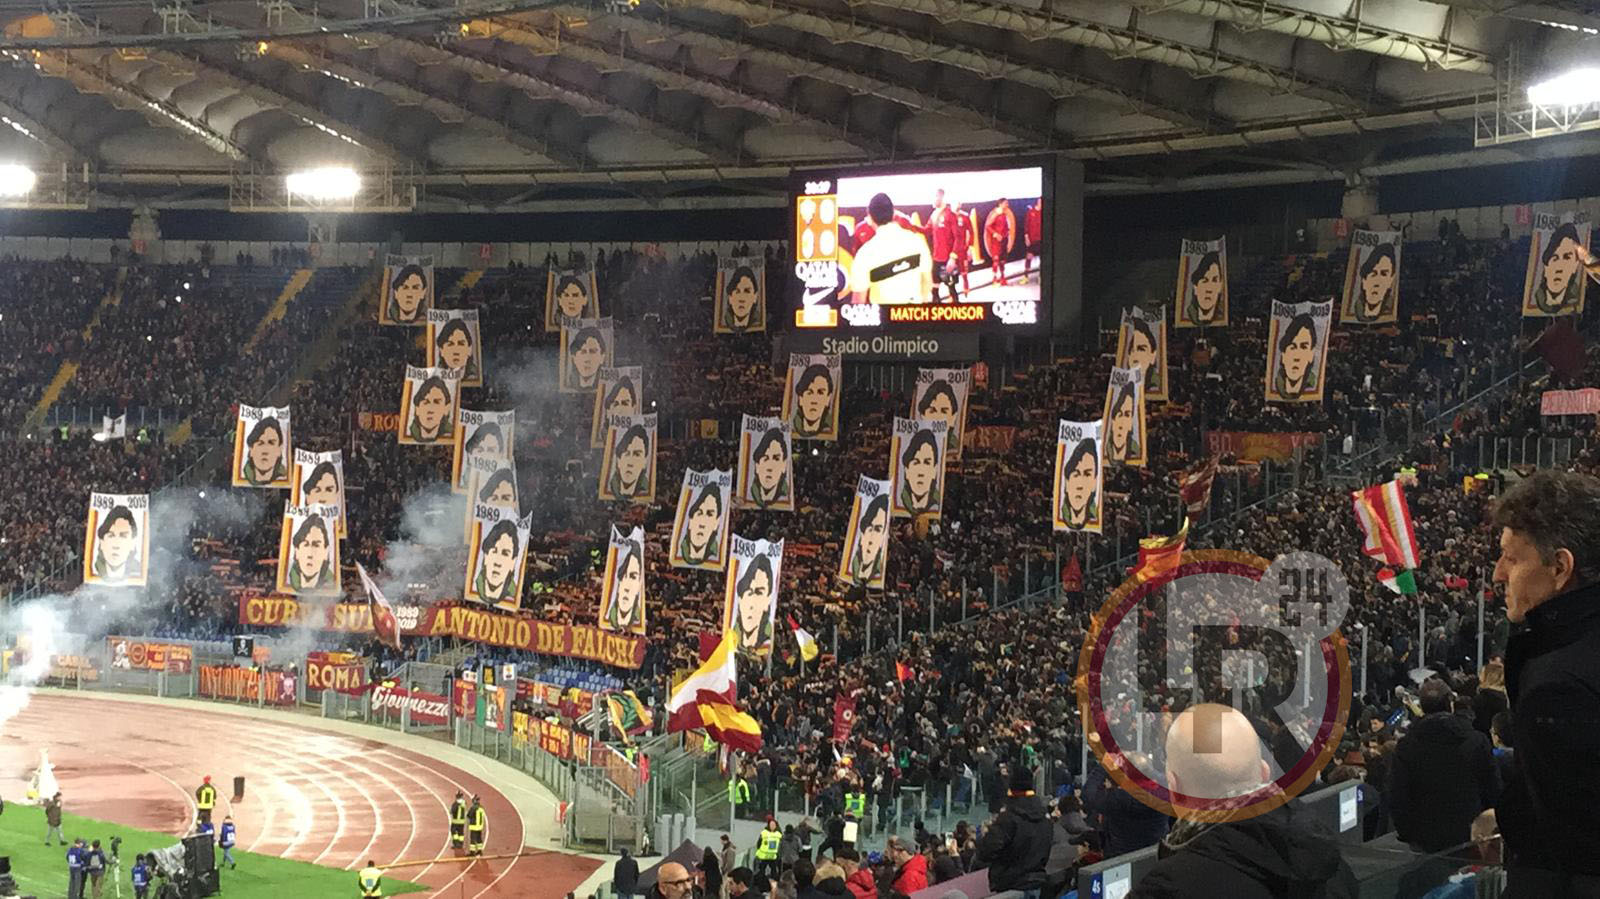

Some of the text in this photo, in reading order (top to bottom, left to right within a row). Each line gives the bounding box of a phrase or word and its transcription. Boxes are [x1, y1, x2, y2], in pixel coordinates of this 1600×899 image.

[1354, 231, 1379, 246] 1989
[1184, 241, 1208, 255] 1989
[429, 310, 450, 323] 1989
[890, 307, 929, 321] MATCH
[931, 306, 984, 321] SPONSOR
[822, 336, 939, 357] Stadio Olimpico
[791, 354, 811, 369] 1989
[407, 367, 429, 381] 1989
[241, 406, 264, 421] 1989
[460, 410, 484, 426] 1989
[610, 414, 632, 429] 1989
[746, 417, 769, 433] 1989
[896, 418, 920, 434] 1989
[1060, 424, 1083, 442] 1989
[297, 450, 321, 465] 1989
[474, 456, 498, 473] 1989
[858, 478, 880, 498] 1989
[94, 495, 147, 510] 1989 2019
[475, 503, 500, 523] 1989
[733, 538, 757, 559] 1989
[397, 605, 419, 618] 1989
[430, 606, 639, 667] ANTONIO DE FALCHI
[308, 663, 361, 688] ROMA
